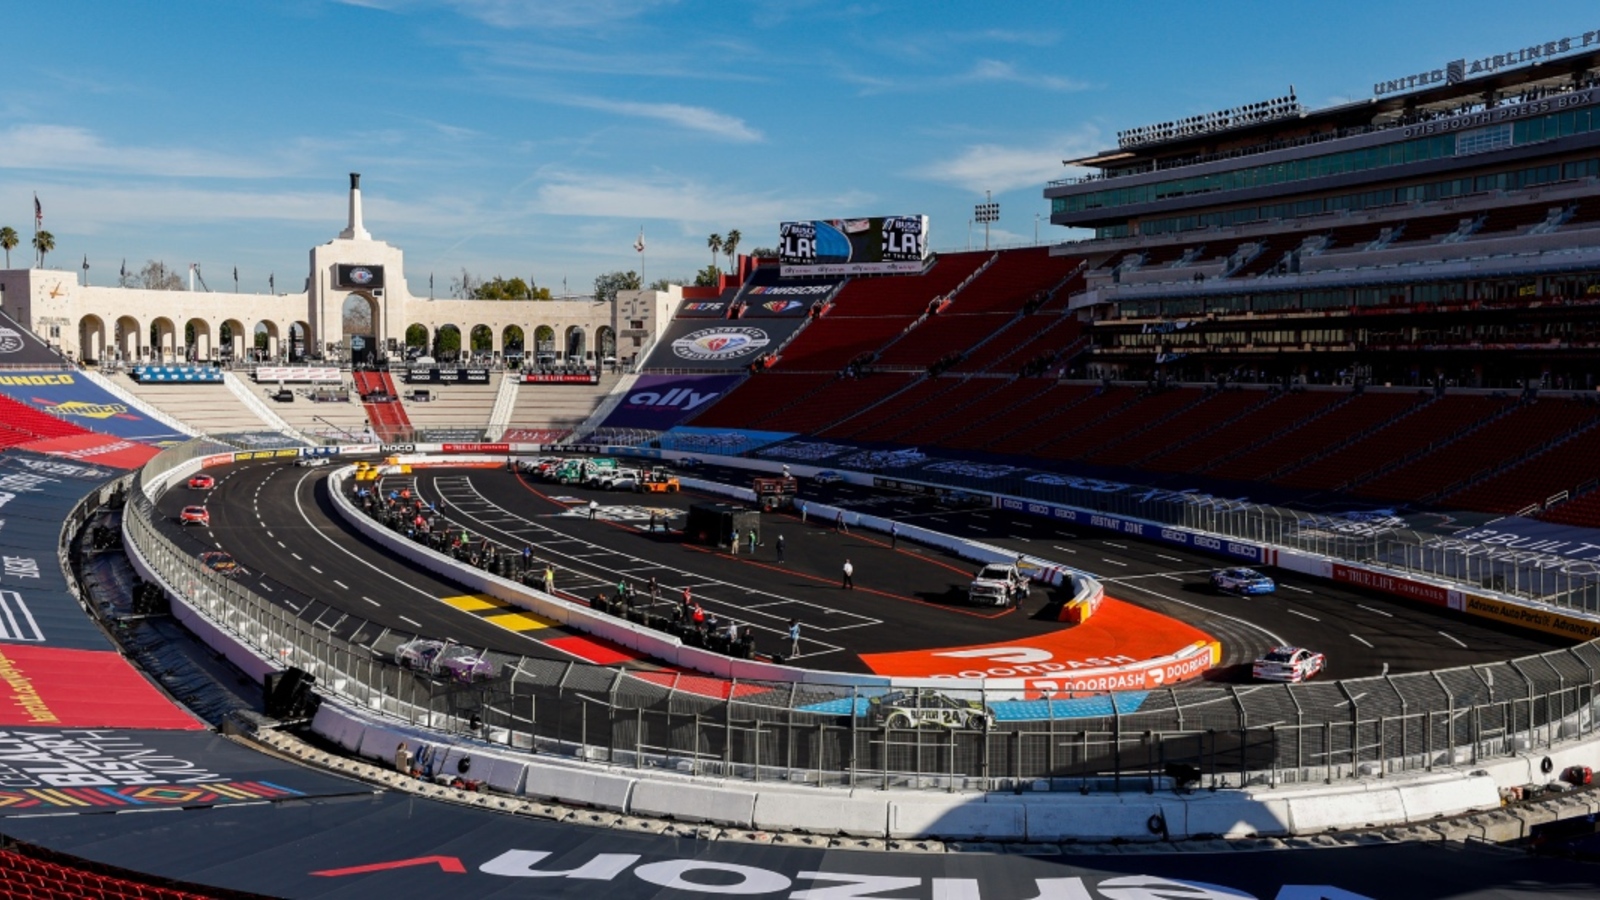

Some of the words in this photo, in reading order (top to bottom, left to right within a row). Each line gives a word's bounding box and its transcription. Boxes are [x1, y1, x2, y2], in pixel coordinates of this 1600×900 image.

[1373, 68, 1443, 95] UNITED
[1469, 37, 1572, 75] AIRLINES
[1403, 124, 1436, 138] OTIS
[1441, 113, 1492, 130] BOOTH
[1501, 101, 1550, 118] PRESS
[1558, 92, 1594, 108] BOX
[766, 285, 833, 295] NASCAR
[0, 374, 75, 386] UNOCO
[44, 402, 128, 416] SUNOCO
[629, 388, 719, 410] ally
[382, 444, 413, 452] NOCO
[1003, 498, 1023, 510] GEICO
[1029, 503, 1049, 515] GEICO
[1055, 507, 1076, 520] GEICO
[1090, 515, 1120, 530] RESTART
[1124, 522, 1143, 535] ZONE
[1161, 528, 1187, 543] GEICO
[1194, 535, 1221, 549] GEICO
[1228, 542, 1256, 557] GEICO
[1347, 567, 1371, 585] TRUE
[1373, 572, 1396, 591] LIFE
[1398, 583, 1444, 601] COMPANIES
[1468, 598, 1499, 614] Advance
[1500, 606, 1520, 619] Auto
[1520, 610, 1542, 625] Parts
[1553, 618, 1589, 636] Advance
[1165, 653, 1209, 679] DOORDASH
[1064, 673, 1145, 692] DOORDASH
[942, 709, 961, 723] 24
[12, 731, 170, 785] HISTORY
[61, 729, 231, 783] MONTH
